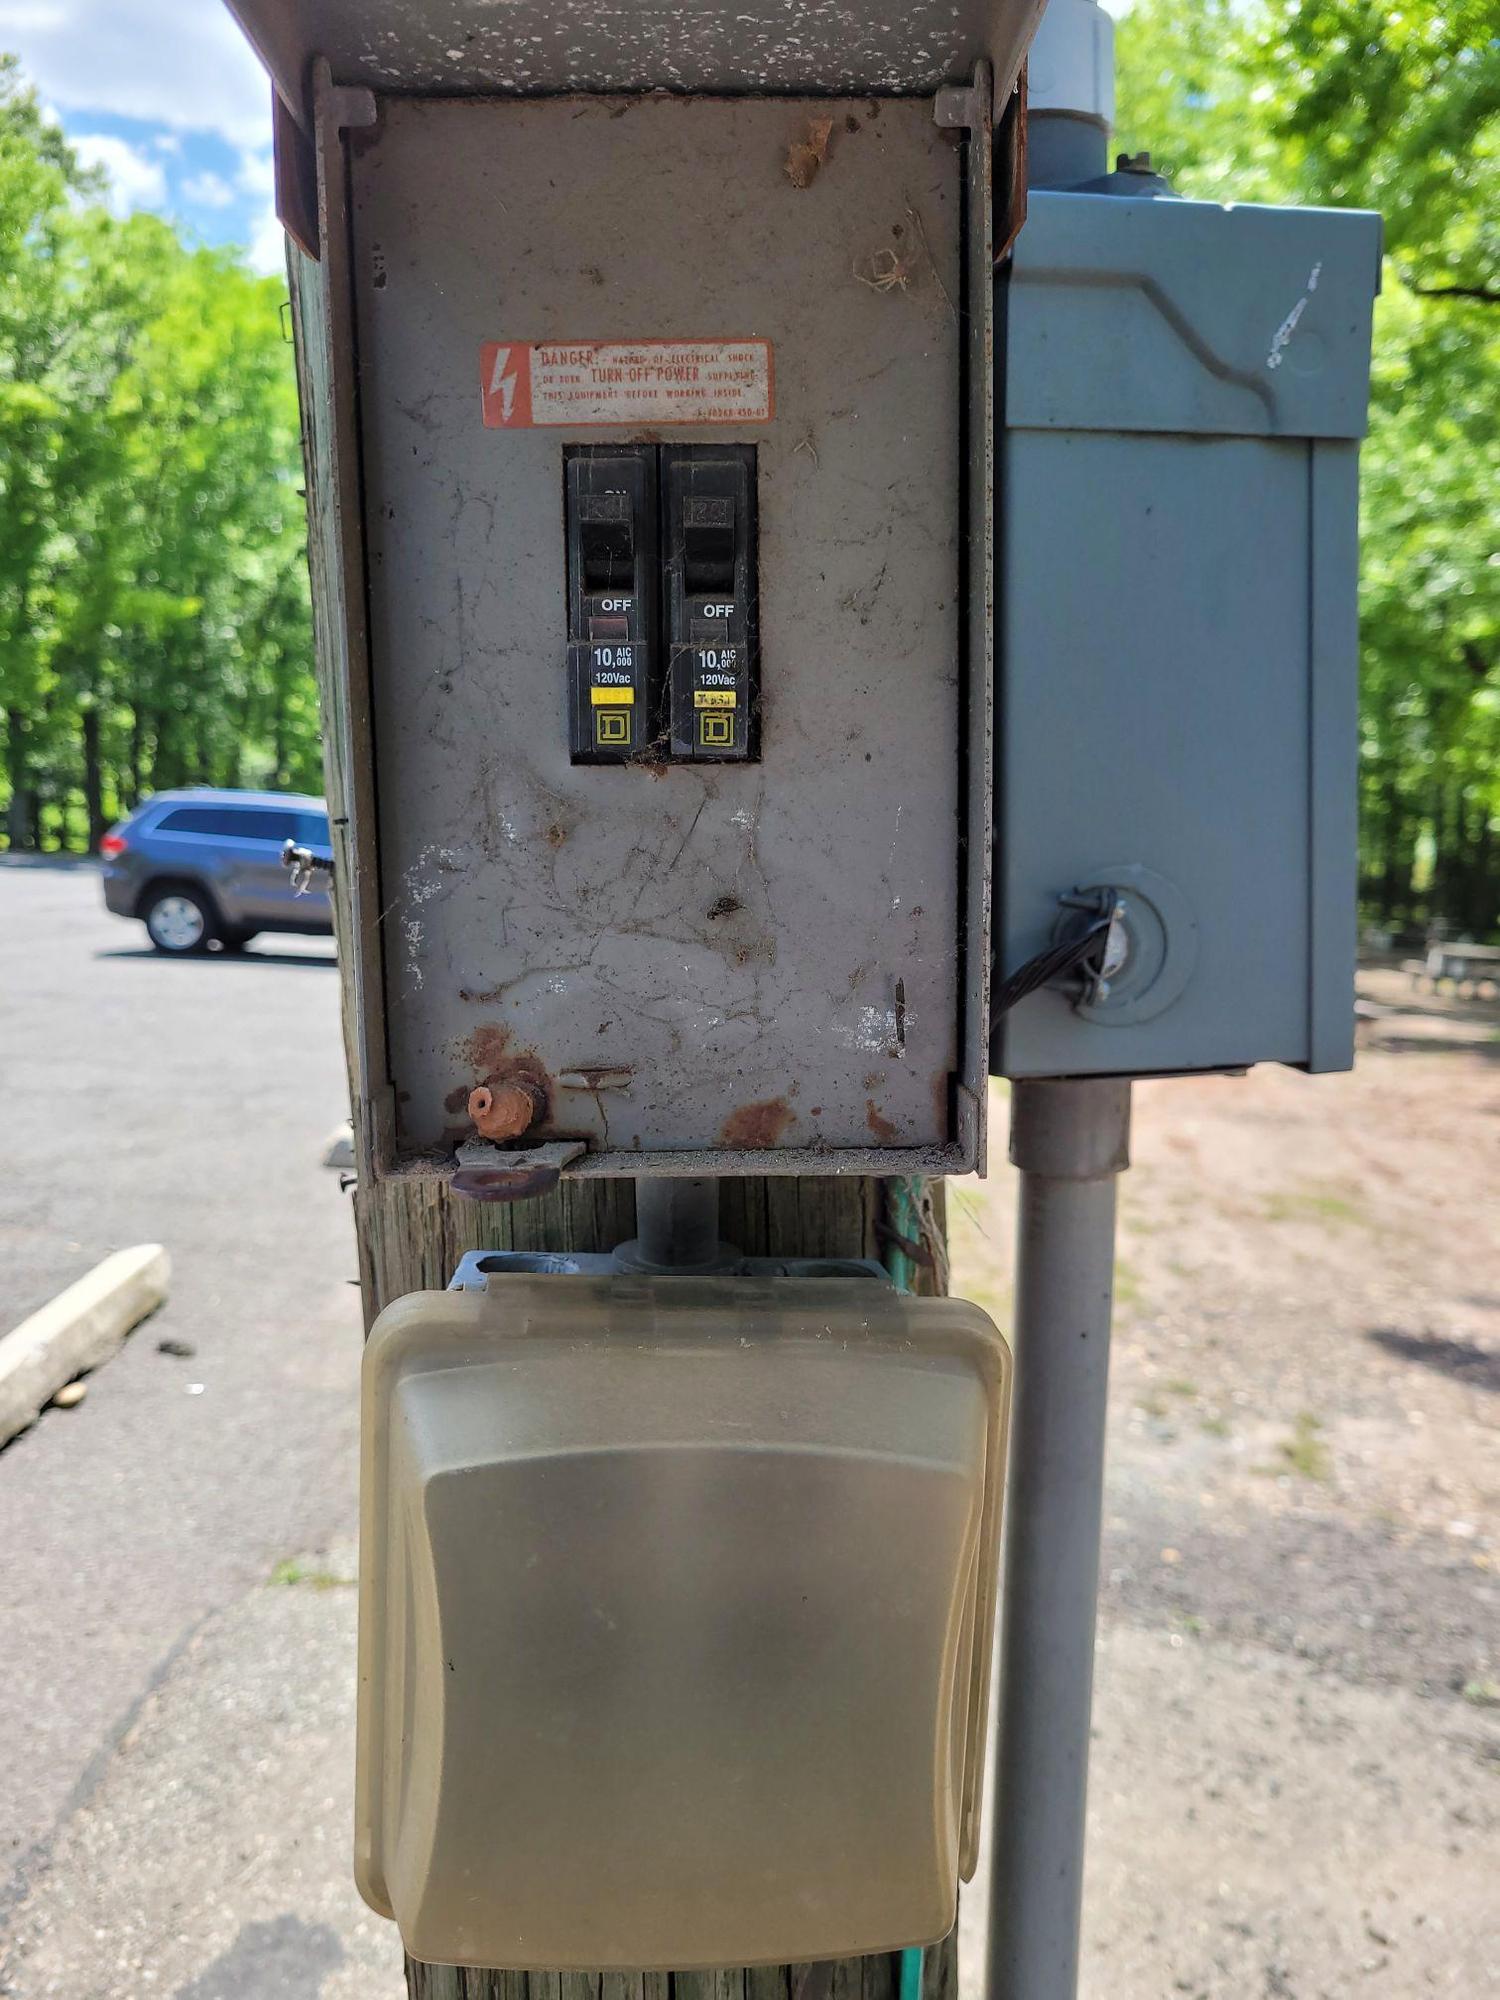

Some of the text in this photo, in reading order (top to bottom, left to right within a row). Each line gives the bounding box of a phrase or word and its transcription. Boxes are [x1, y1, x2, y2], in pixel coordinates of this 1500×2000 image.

[591, 368, 624, 383] TURN
[629, 367, 652, 382] OFF
[657, 366, 700, 382] POWER
[665, 388, 706, 399] WORKING
[601, 599, 632, 612] OFF
[703, 604, 735, 618] OFF
[616, 647, 632, 658] AIC
[721, 649, 737, 660] AIC
[595, 672, 631, 684] 120Vac
[700, 674, 736, 686] 120Vac
